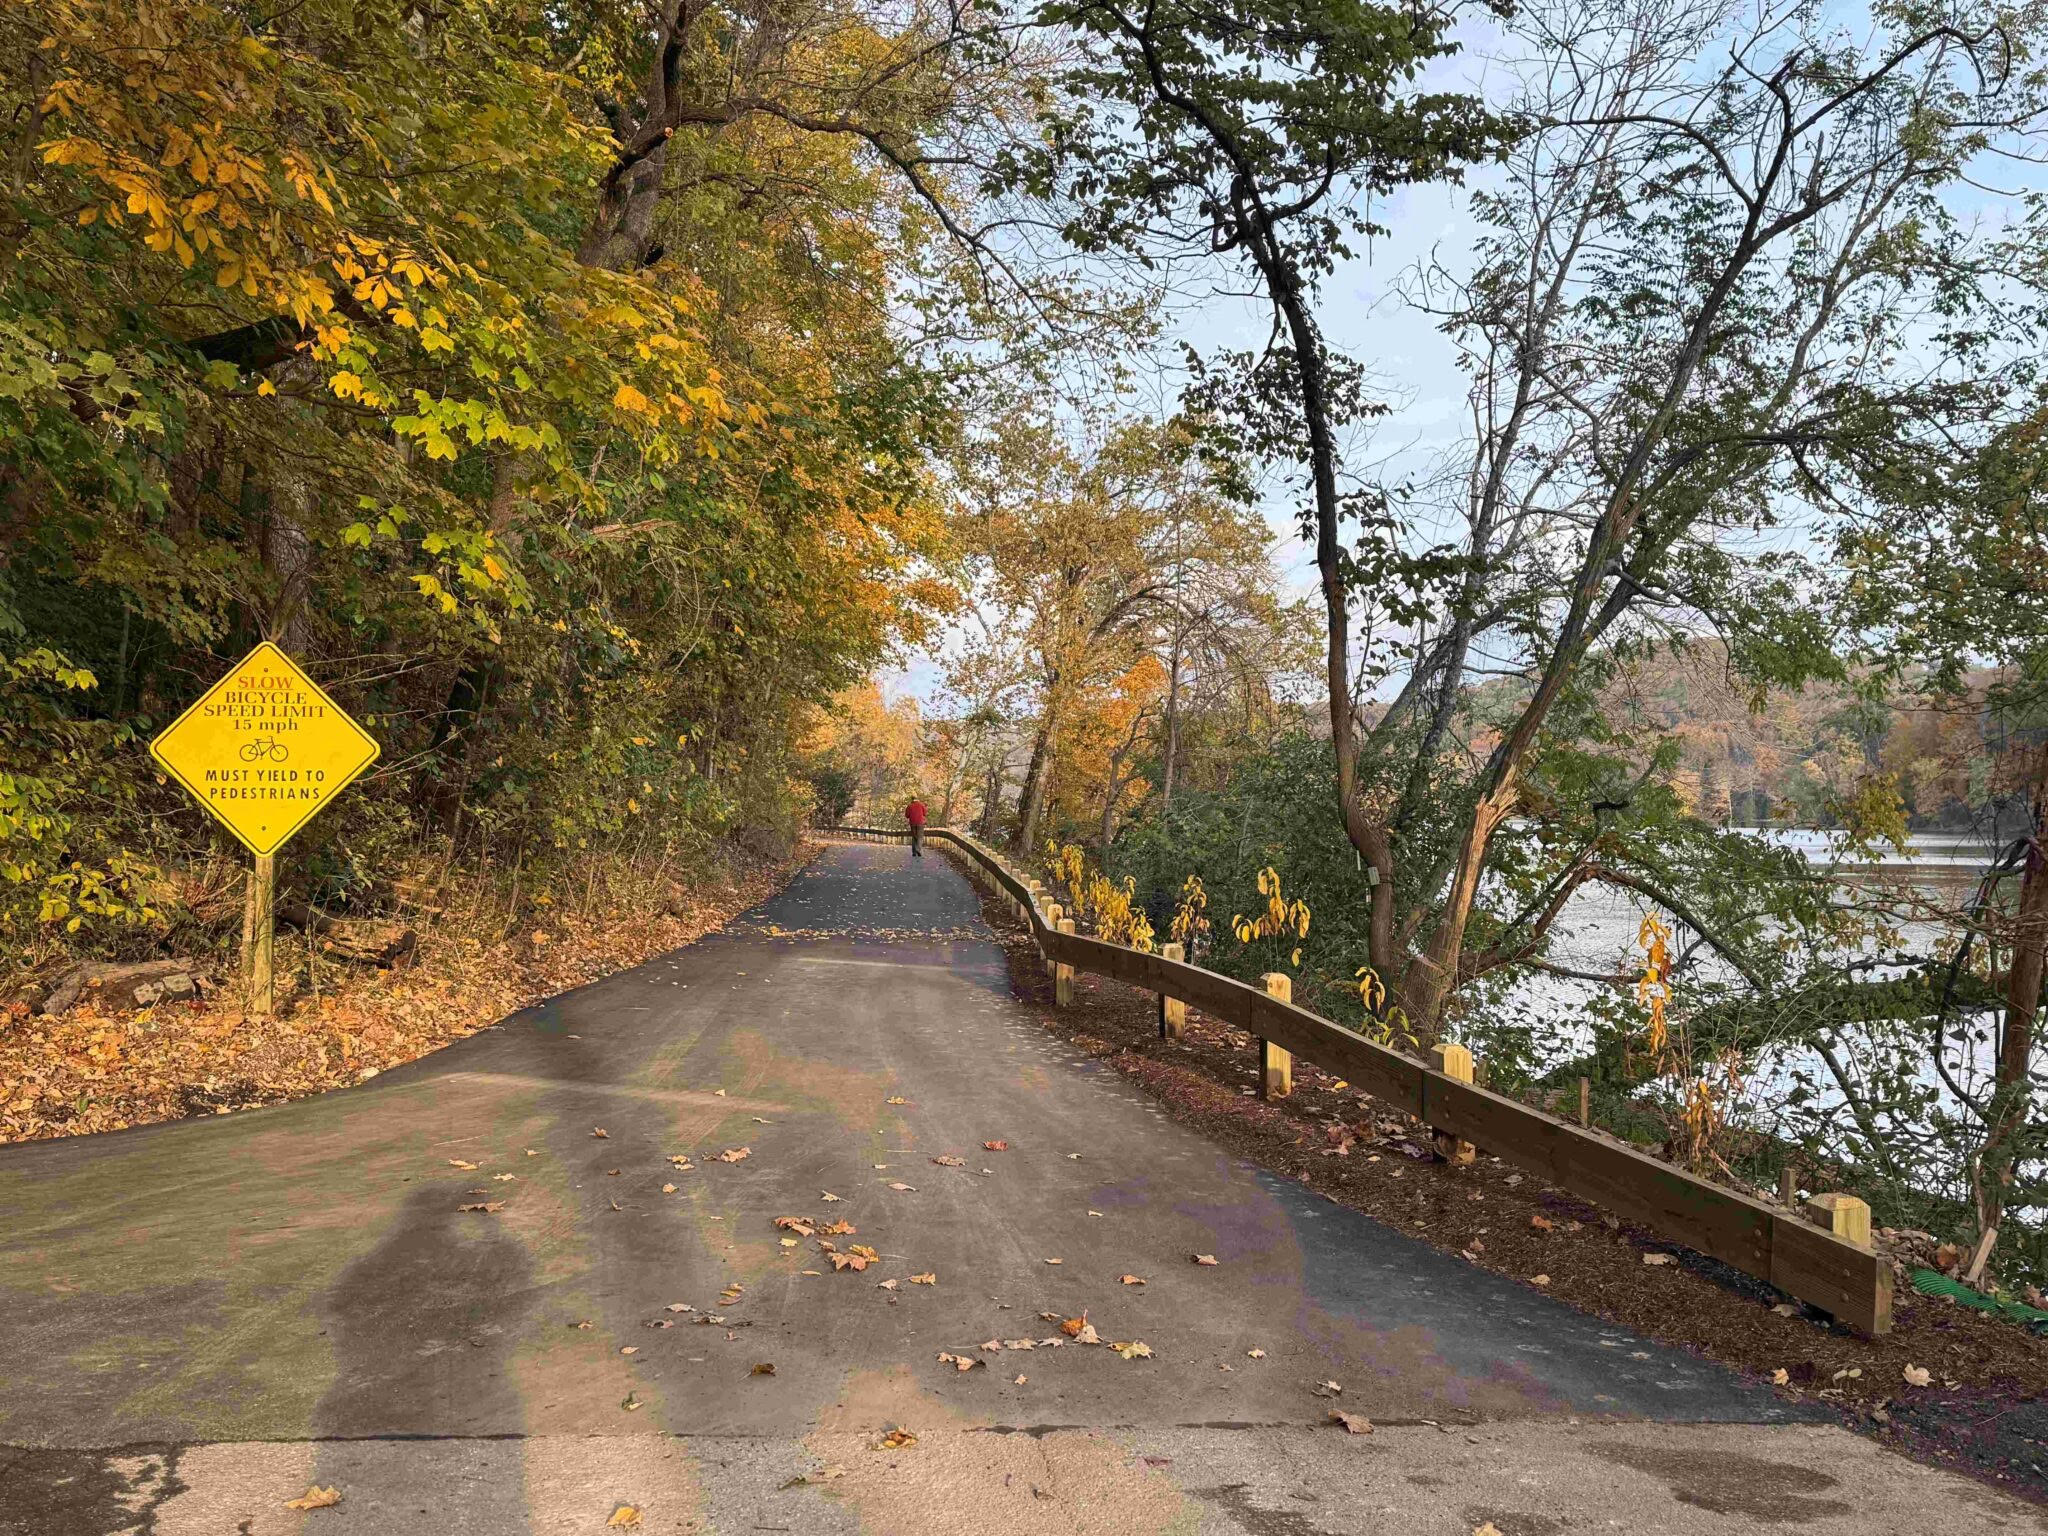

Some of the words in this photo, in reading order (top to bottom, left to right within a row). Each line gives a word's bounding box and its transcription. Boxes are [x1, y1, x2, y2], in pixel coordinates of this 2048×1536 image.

[238, 676, 294, 689] SLOW
[225, 691, 307, 704] BICYCLE
[204, 705, 265, 717] SPEED
[271, 706, 327, 718] LIMIT
[234, 719, 252, 730] 15
[259, 718, 298, 733] mph
[205, 769, 249, 781] MUST
[257, 769, 298, 781] YIELD
[306, 769, 325, 781] TO
[210, 787, 320, 799] PEDESTRIANS
